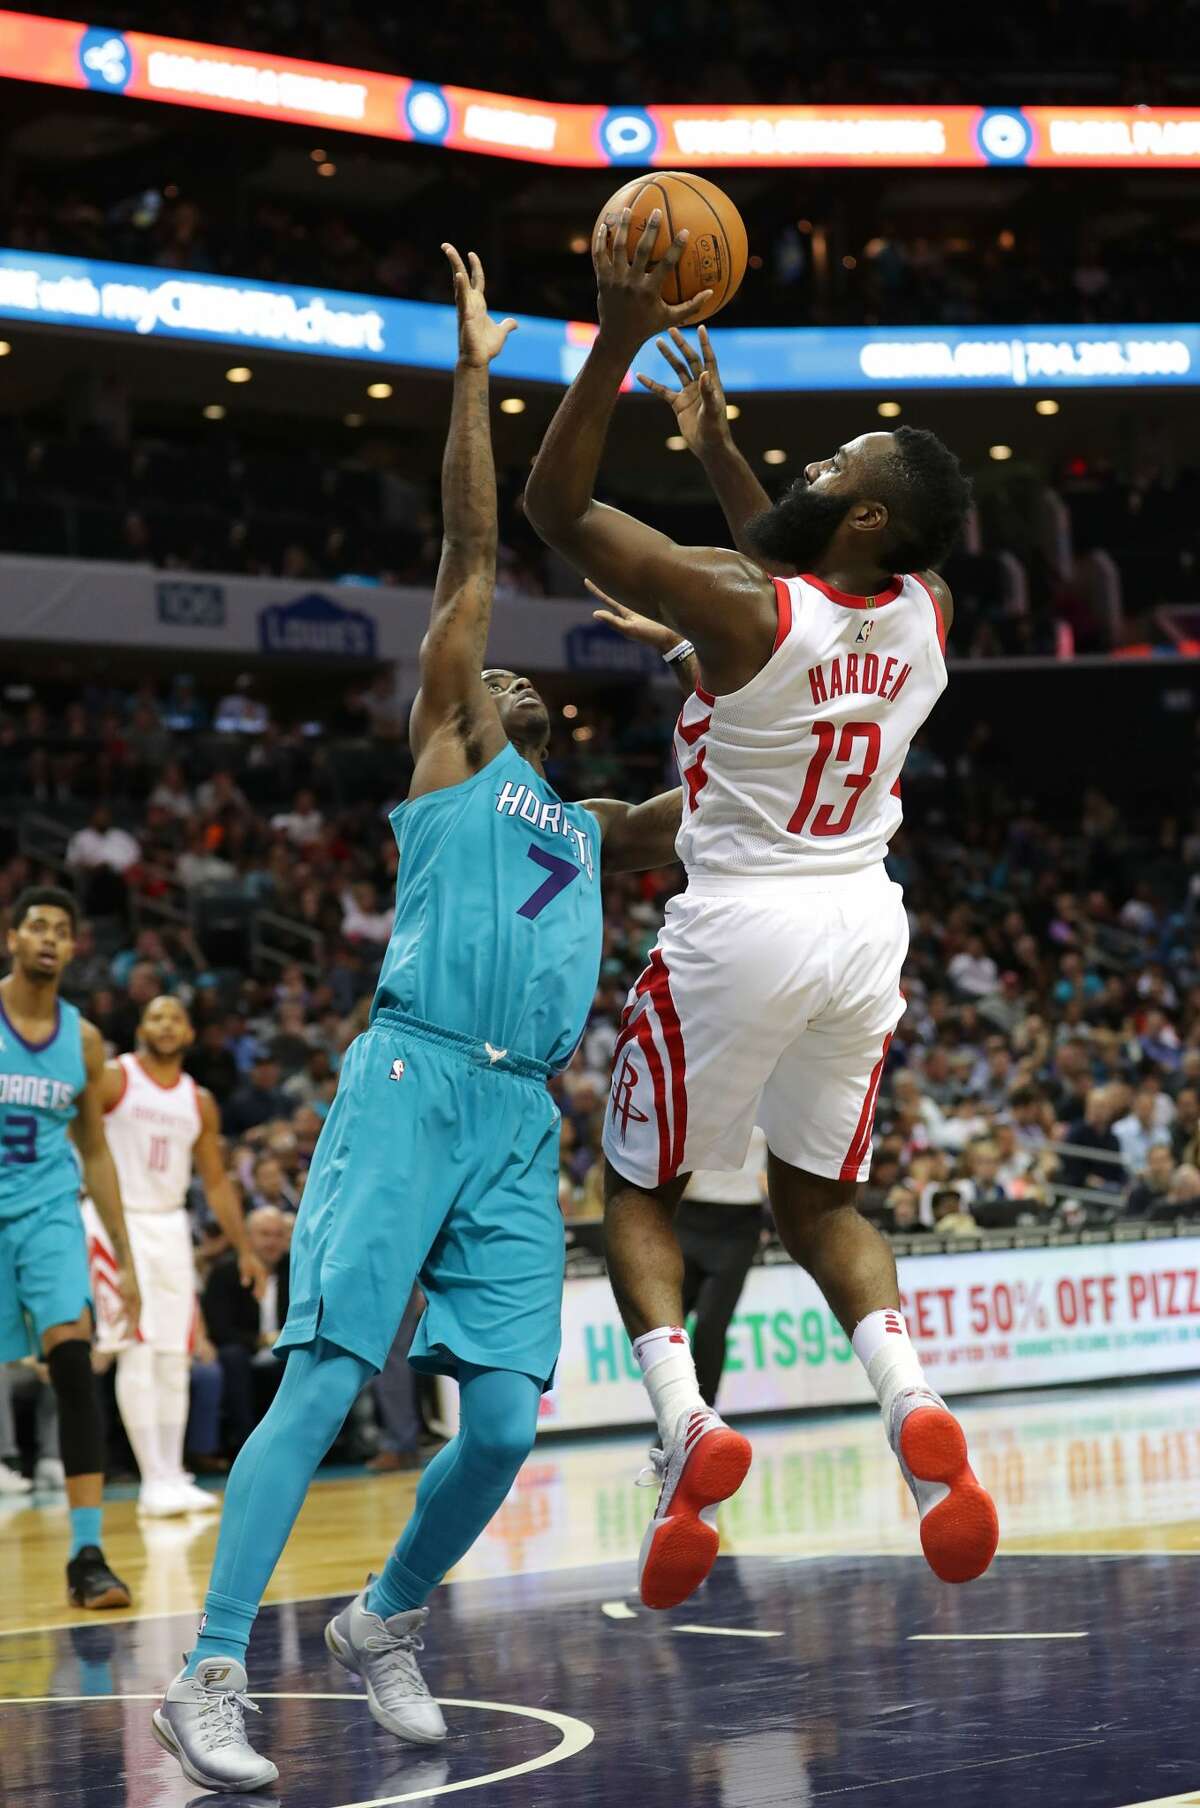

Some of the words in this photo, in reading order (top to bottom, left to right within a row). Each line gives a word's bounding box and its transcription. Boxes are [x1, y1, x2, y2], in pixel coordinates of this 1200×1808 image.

[808, 653, 912, 705] HARDEN
[786, 721, 881, 836] 13
[516, 842, 580, 920] 7
[3, 1115, 38, 1163] 3
[968, 1279, 1048, 1334] 50%
[1057, 1275, 1117, 1327] OFF
[1128, 1268, 1200, 1321] PIZZ
